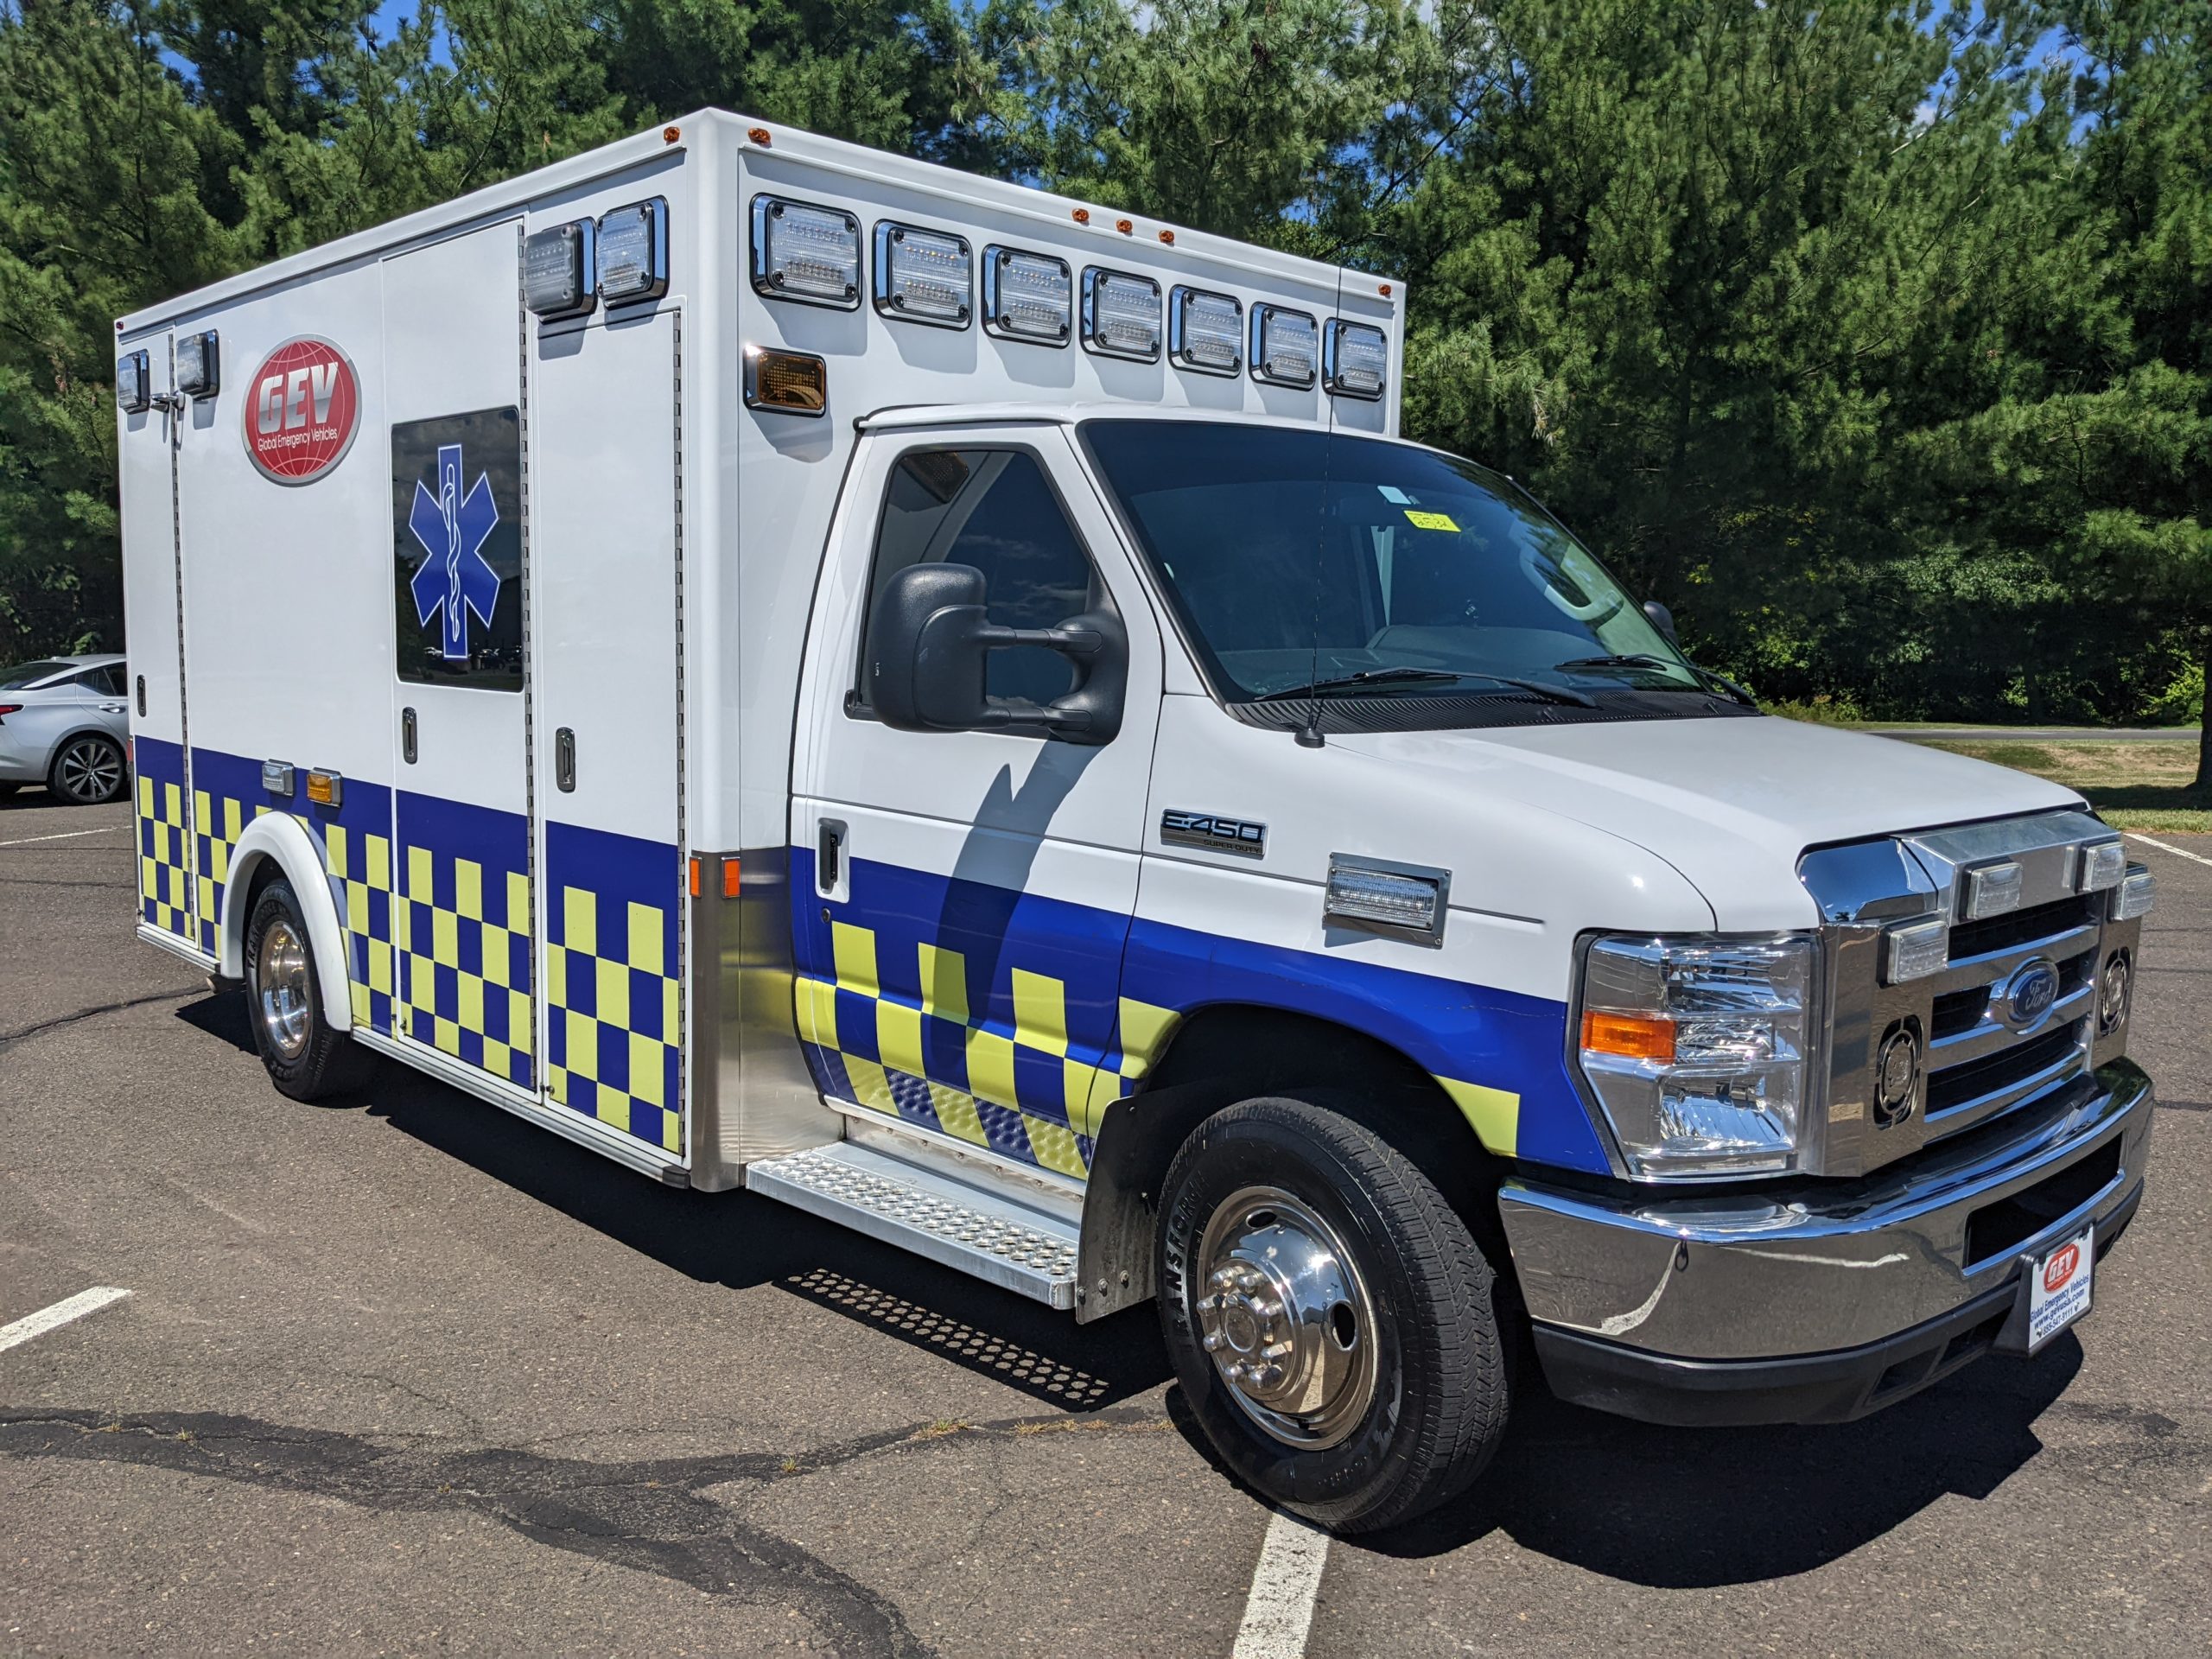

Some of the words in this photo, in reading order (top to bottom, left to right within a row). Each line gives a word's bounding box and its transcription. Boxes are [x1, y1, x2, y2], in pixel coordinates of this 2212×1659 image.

[258, 361, 338, 435] GEV
[257, 435, 276, 452] Global
[277, 432, 310, 449] Emergency
[311, 426, 338, 442] Vehicles
[1162, 811, 1264, 843] E-450
[1203, 839, 1233, 849] SUPER
[1234, 843, 1260, 853] DUTY
[2025, 978, 2052, 1010] Ford
[2048, 1248, 2075, 1283] GEV
[2030, 1302, 2044, 1322] Global
[2044, 1287, 2069, 1312] Emergency
[2070, 1274, 2089, 1293] Vehicles
[2035, 1288, 2084, 1330] www.gevusa.com
